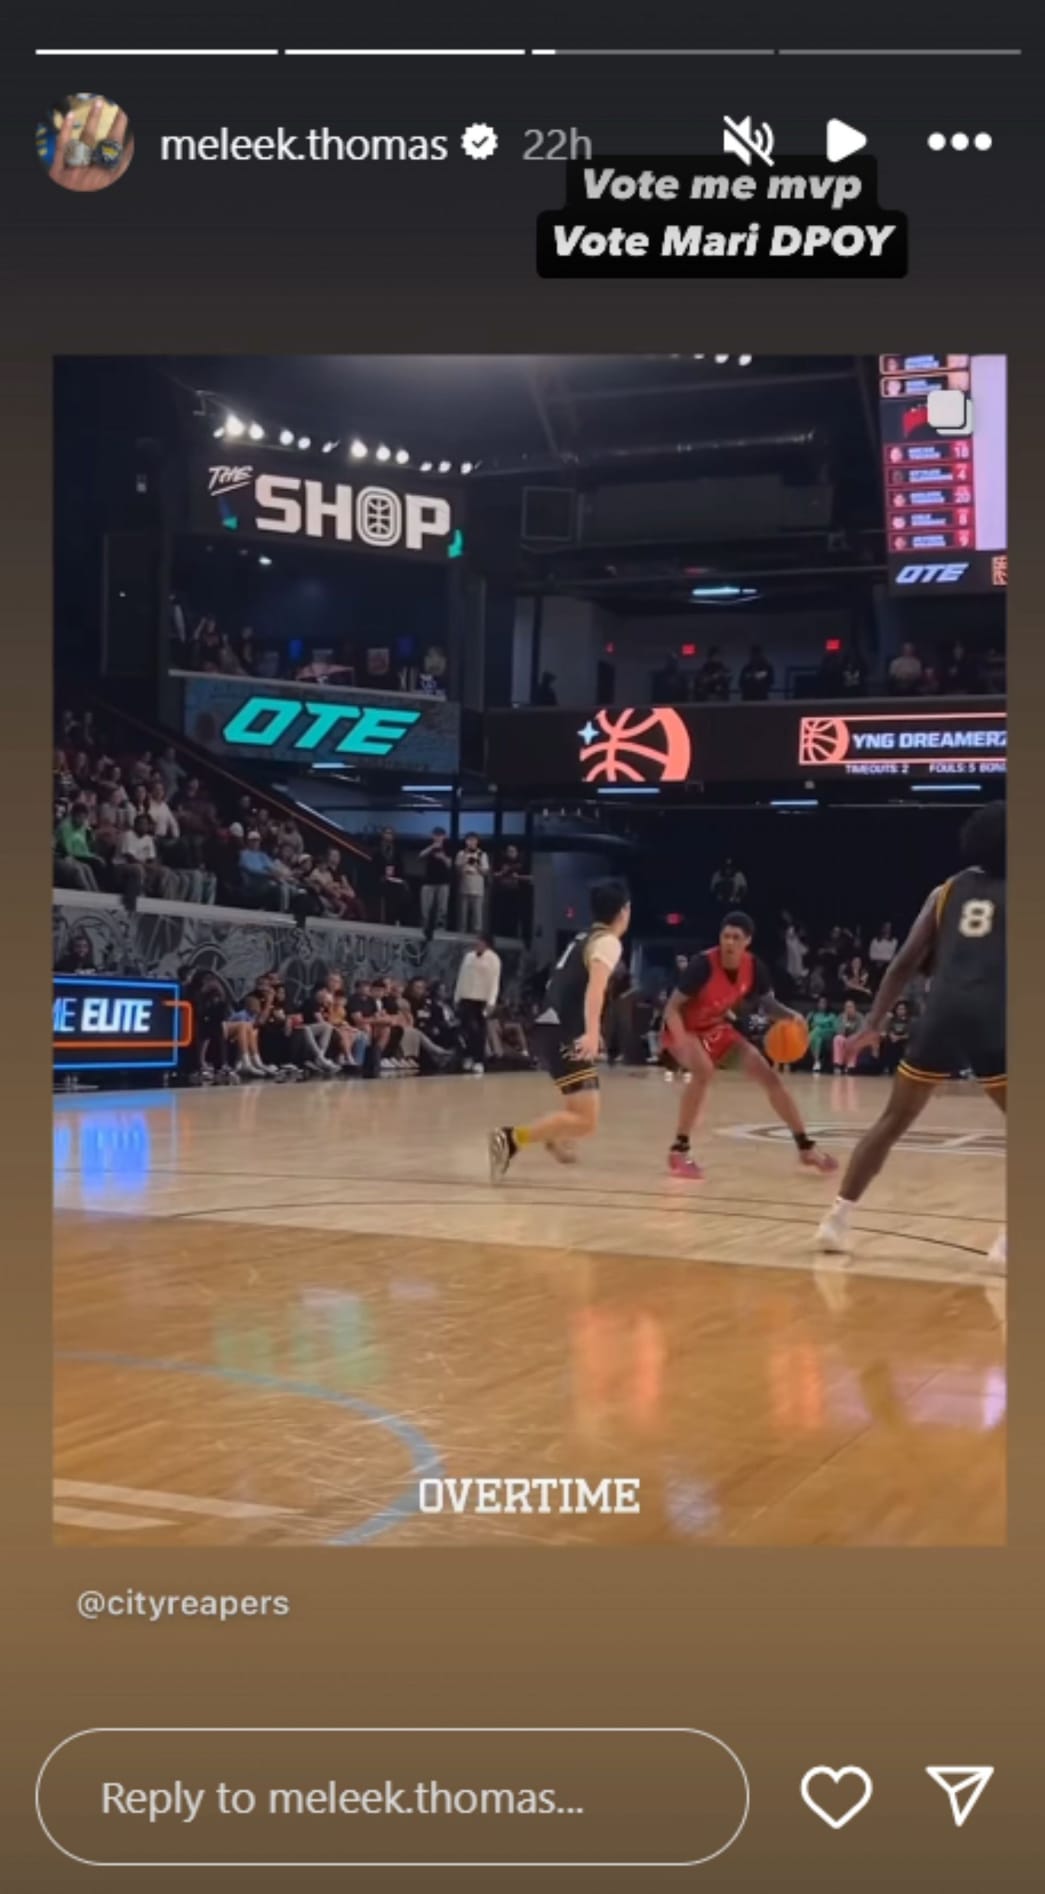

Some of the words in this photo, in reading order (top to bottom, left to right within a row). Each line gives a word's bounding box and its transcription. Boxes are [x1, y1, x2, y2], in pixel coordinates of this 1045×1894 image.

[254, 473, 451, 551] SHOP
[895, 563, 969, 584] OTE
[222, 696, 422, 756] OTE
[852, 732, 895, 749] YNG
[959, 898, 995, 938] 8
[80, 998, 153, 1032] ELITE
